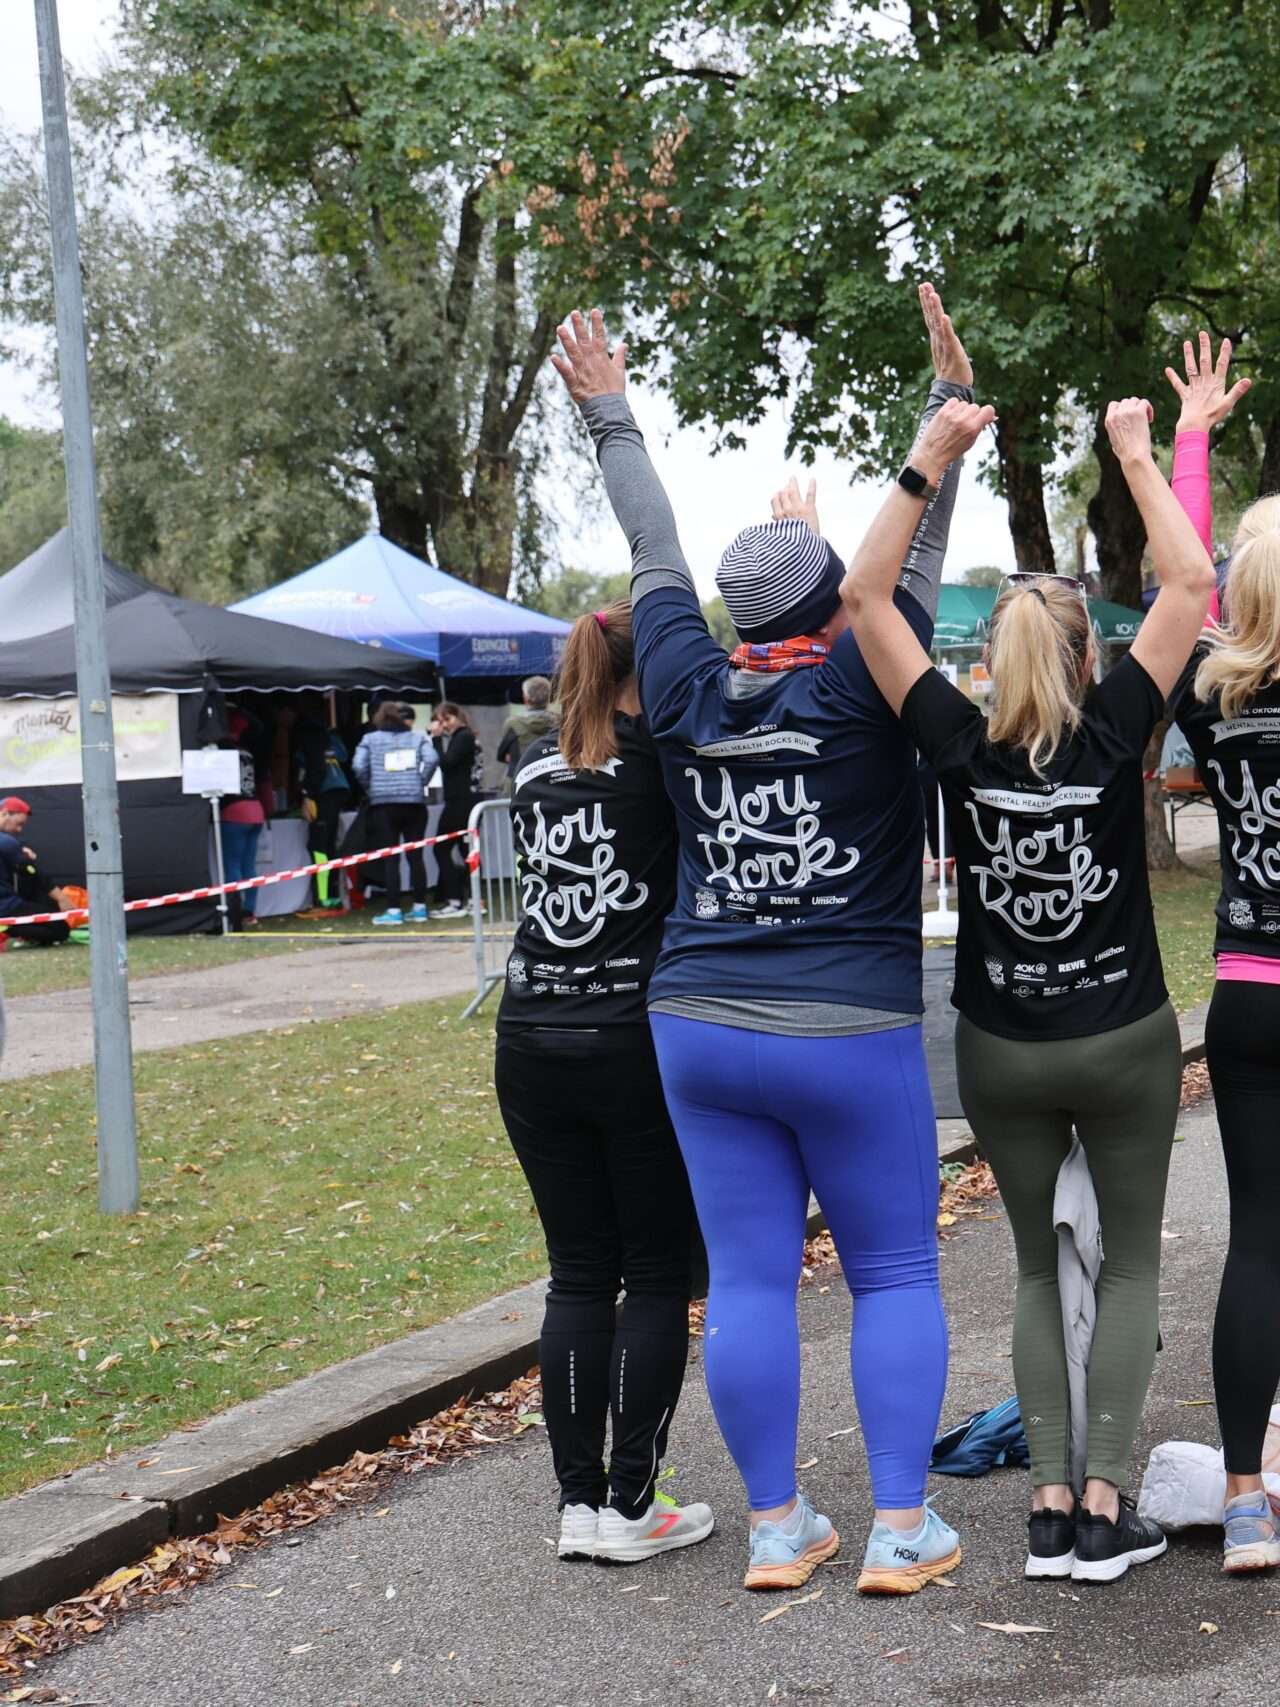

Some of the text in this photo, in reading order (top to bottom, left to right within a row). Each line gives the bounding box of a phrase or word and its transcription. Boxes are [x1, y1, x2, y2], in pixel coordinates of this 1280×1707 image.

[731, 742, 763, 752] HEALTH
[765, 737, 792, 746] ROCKS
[795, 737, 810, 747] RUN
[1226, 722, 1256, 731] MENTAL
[685, 766, 821, 844] You
[987, 793, 1020, 806] MENTAL
[1022, 799, 1052, 809] HEALTH
[1053, 792, 1073, 804] OCKS
[1074, 792, 1091, 800] RUN
[514, 801, 616, 875] You
[697, 813, 861, 891] Rock
[964, 800, 1092, 880] You
[522, 843, 649, 948] Rock
[726, 891, 849, 905] AOK REWE Umschau
[969, 844, 1119, 943] Rock
[1014, 963, 1035, 974] AOK
[1058, 958, 1087, 974] REWE
[893, 1546, 920, 1563] HOKA
